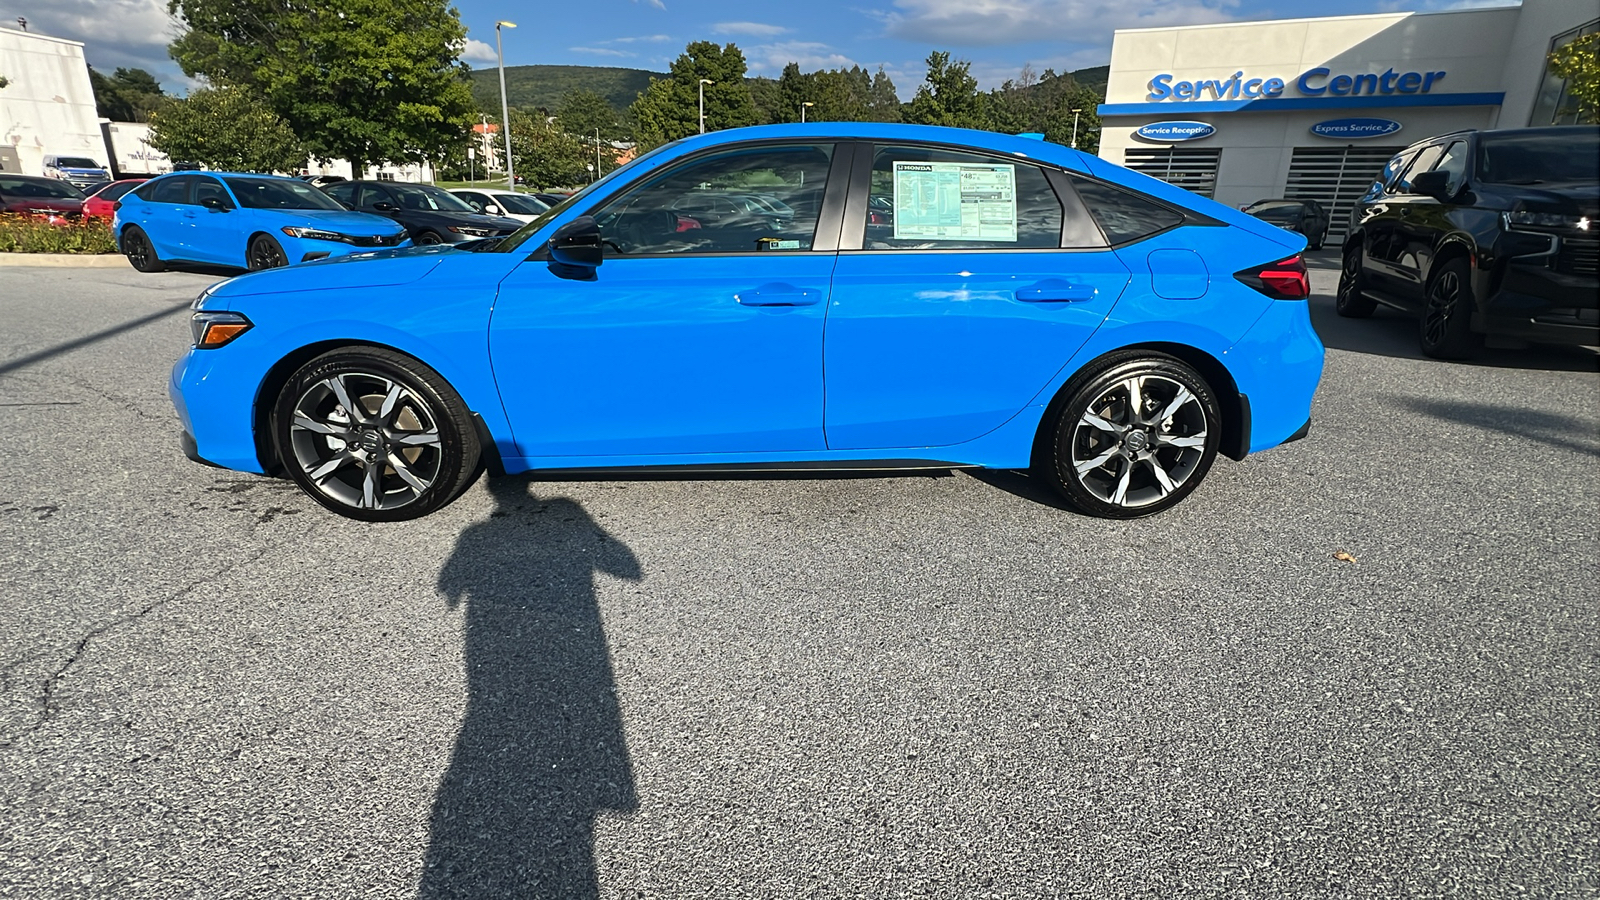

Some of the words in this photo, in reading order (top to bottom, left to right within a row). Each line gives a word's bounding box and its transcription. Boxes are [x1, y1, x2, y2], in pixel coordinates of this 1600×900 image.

[1149, 70, 1285, 100] Service
[1297, 67, 1447, 96] Center
[1172, 126, 1211, 136] Reception
[1315, 124, 1348, 133] Express
[1350, 123, 1383, 132] Service
